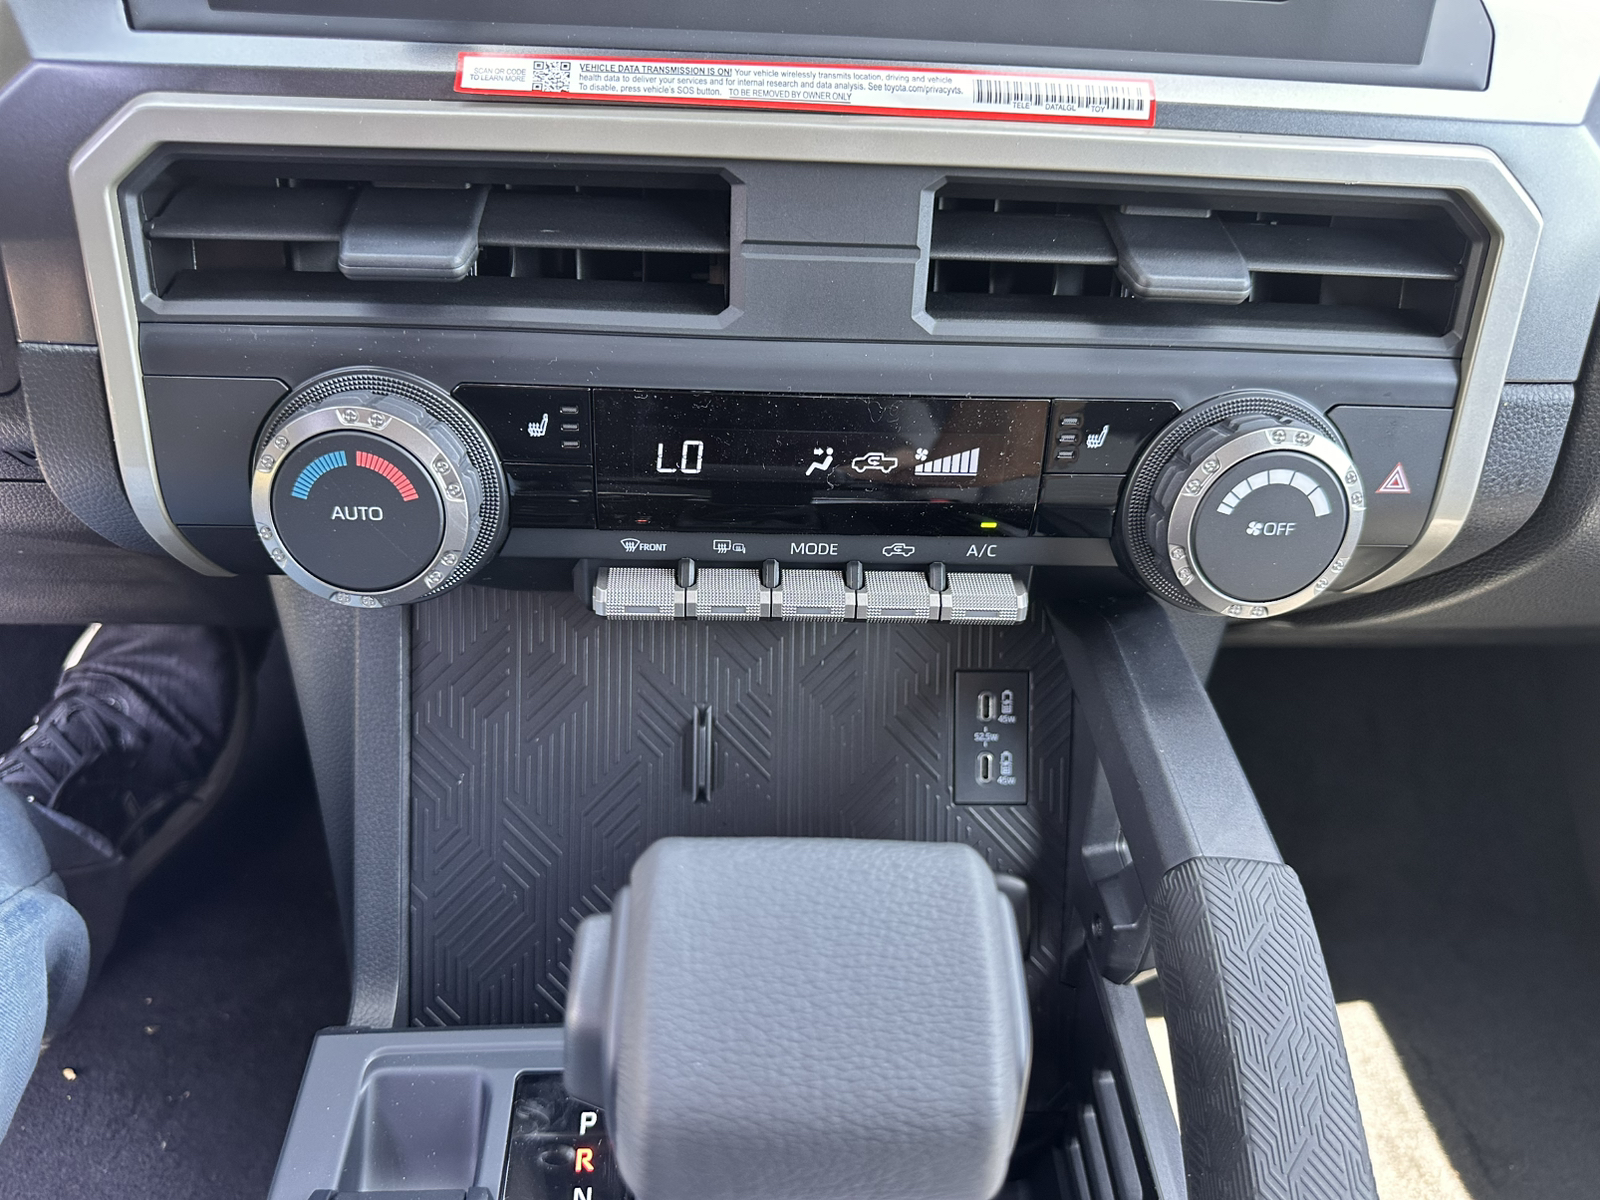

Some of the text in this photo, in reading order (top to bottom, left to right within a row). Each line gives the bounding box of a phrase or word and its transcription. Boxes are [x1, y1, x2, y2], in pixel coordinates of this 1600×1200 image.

[580, 63, 616, 72] VEHICLE
[618, 64, 640, 73] DATA
[642, 66, 705, 75] TRANSMISSION
[718, 68, 732, 77] ON!
[781, 70, 816, 79] wirelessly
[818, 71, 851, 80] transmits
[853, 72, 884, 81] location,
[886, 74, 909, 83] driving
[579, 73, 601, 82] health
[604, 74, 620, 82] data
[632, 75, 657, 83] deliver
[658, 77, 675, 85] your
[737, 79, 764, 87] internal
[766, 80, 798, 88] research
[834, 82, 866, 91] analysis.
[868, 82, 882, 91] See
[590, 83, 618, 92] disable,
[643, 86, 675, 94] vehicle's
[677, 86, 694, 94] SOS
[696, 87, 722, 96] button.
[729, 88, 739, 96] TO
[752, 89, 790, 98] REMOVED
[803, 91, 831, 100] OWNER
[832, 92, 852, 100] ONLY
[330, 506, 384, 521] AUTO
[1263, 522, 1296, 536] OFF
[640, 543, 667, 552] FRONT
[790, 542, 838, 555] MODE
[966, 543, 997, 557] A/C
[580, 1111, 597, 1136] P
[575, 1148, 594, 1172] R
